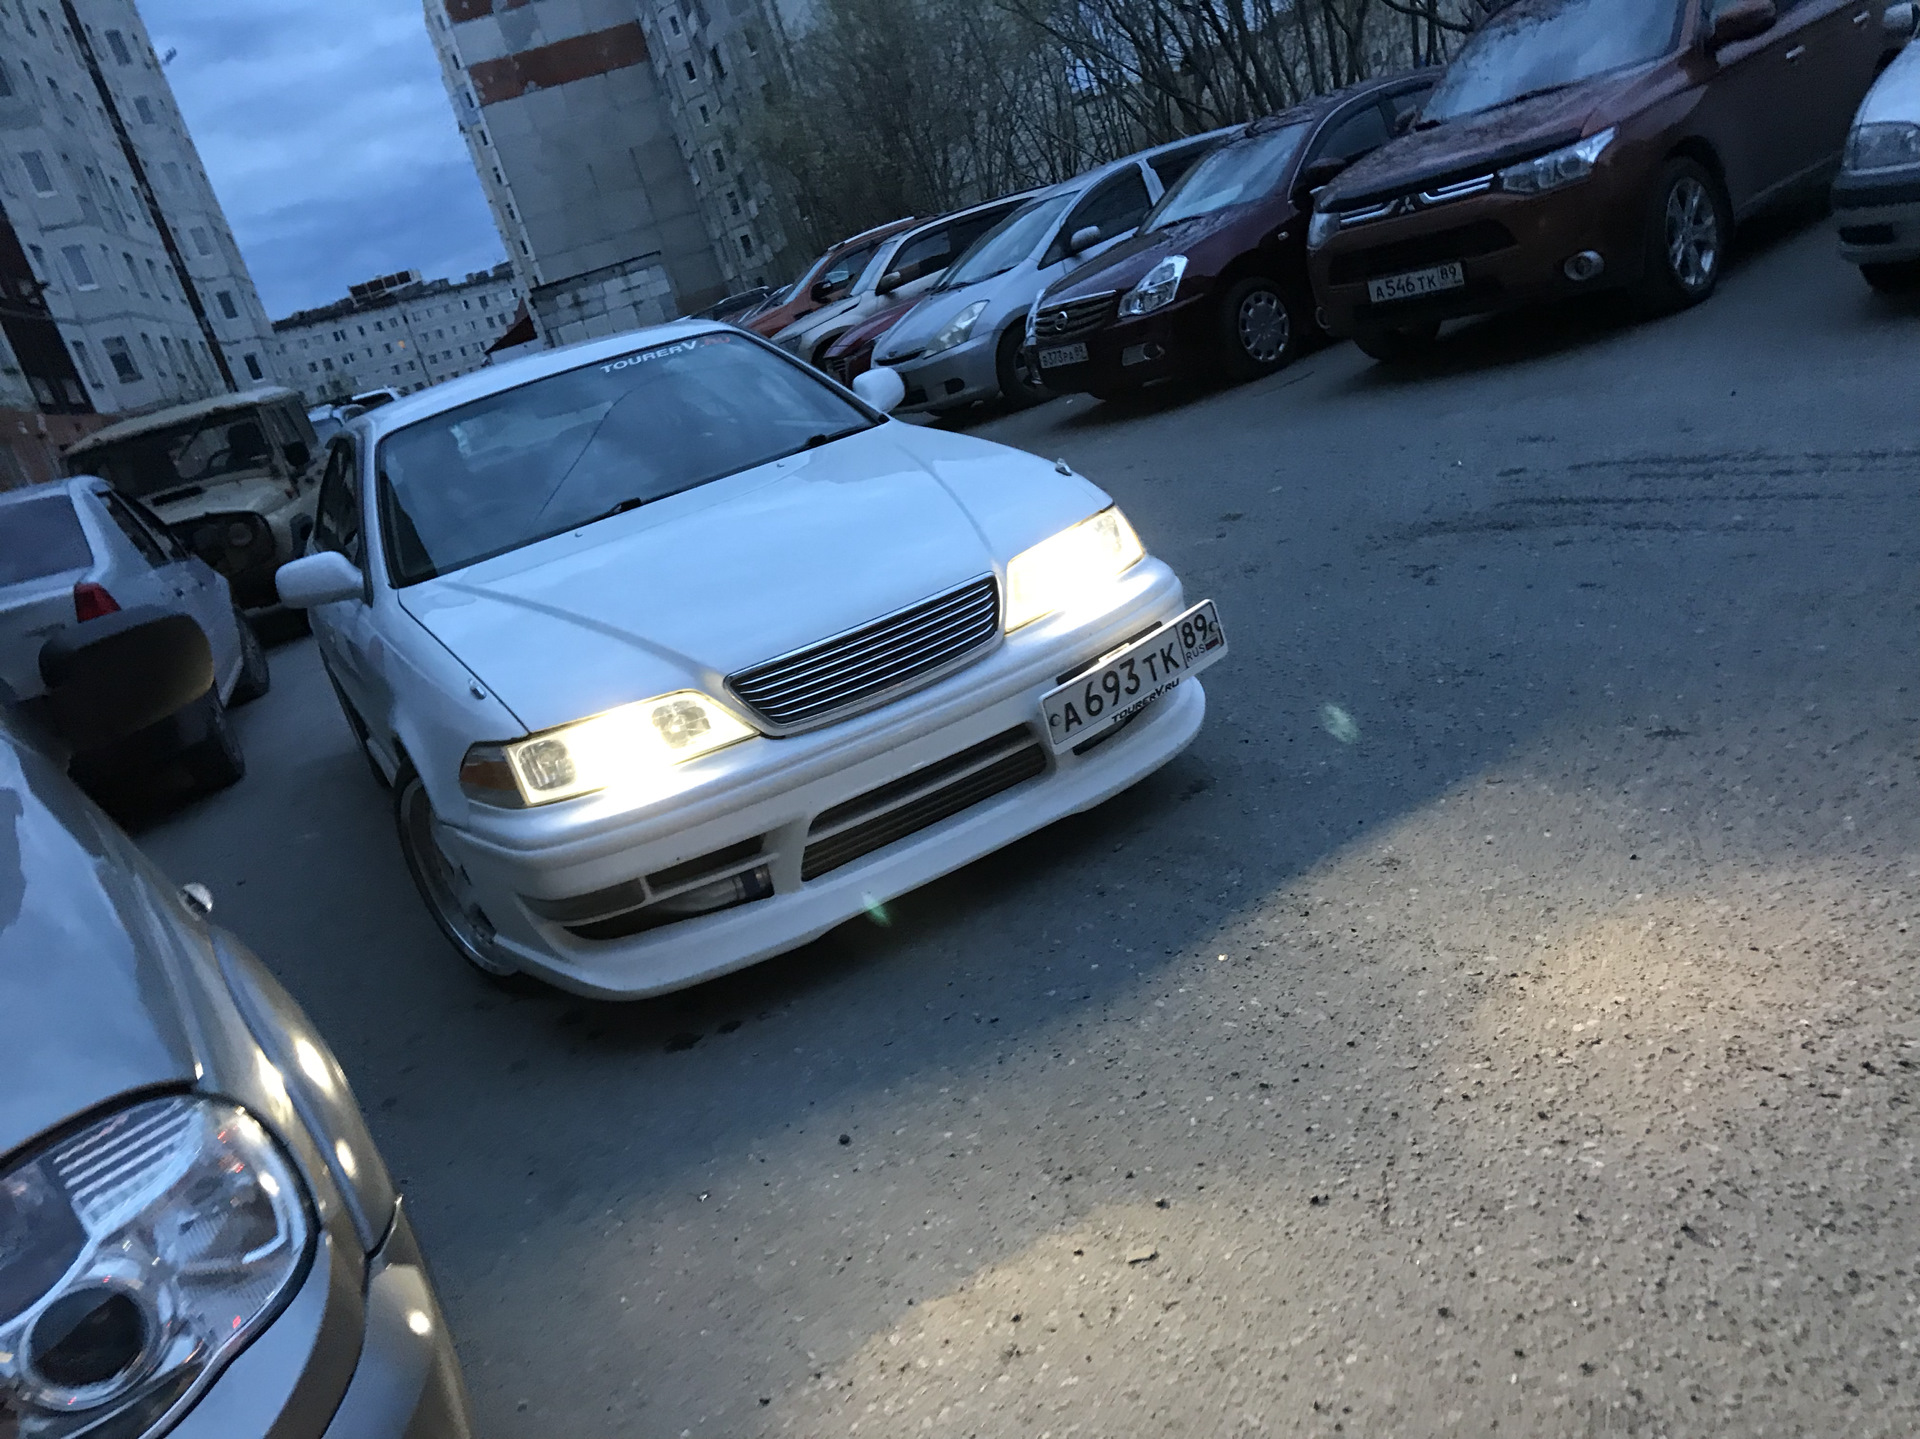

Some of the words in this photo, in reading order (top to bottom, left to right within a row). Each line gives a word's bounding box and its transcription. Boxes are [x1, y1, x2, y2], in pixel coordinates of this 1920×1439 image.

[1376, 273, 1437, 300] A546TK
[1185, 643, 1206, 662] RUS
[1063, 642, 1180, 733] A693TK
[1182, 614, 1207, 649] 89
[1111, 677, 1180, 723] TOURERV.RU
